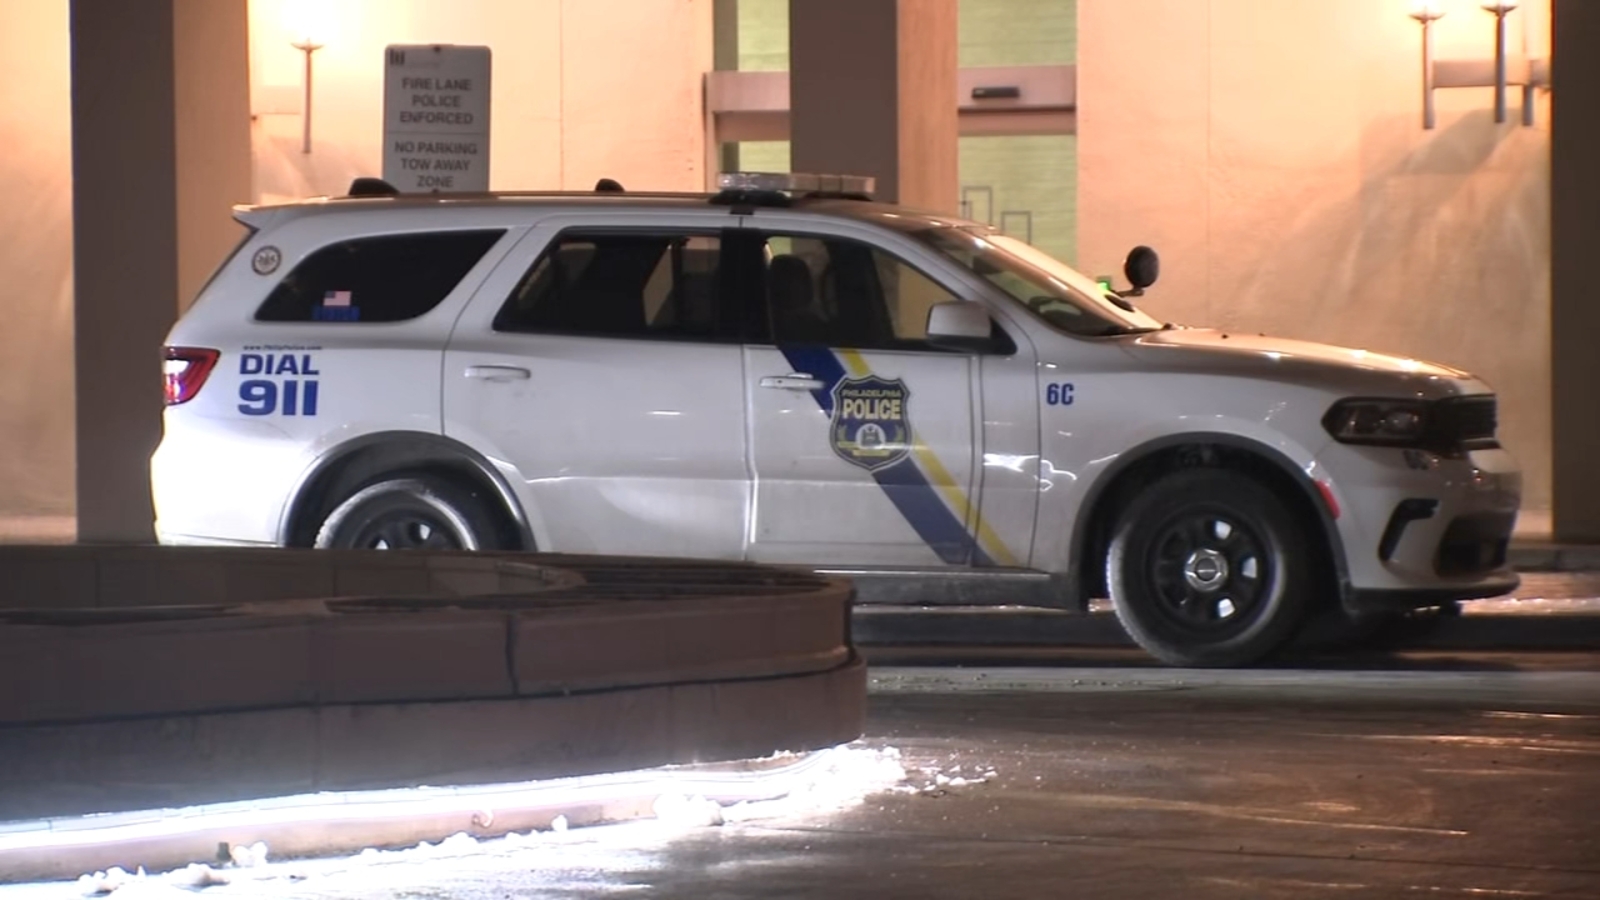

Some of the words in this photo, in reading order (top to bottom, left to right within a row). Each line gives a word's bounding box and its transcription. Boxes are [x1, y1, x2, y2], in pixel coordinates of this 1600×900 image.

[402, 78, 432, 90] FIRE
[435, 79, 472, 91] LANE
[412, 95, 461, 107] POLICE
[400, 112, 474, 124] ENFORCED
[395, 142, 415, 153] NO
[418, 142, 477, 155] PARKING
[401, 159, 431, 170] TOW
[434, 160, 471, 171] AWAY
[417, 176, 454, 188] ZONE
[239, 354, 320, 375] DIAL
[238, 380, 319, 416] 911
[1046, 383, 1075, 406] 6C
[842, 398, 902, 420] POLICE
